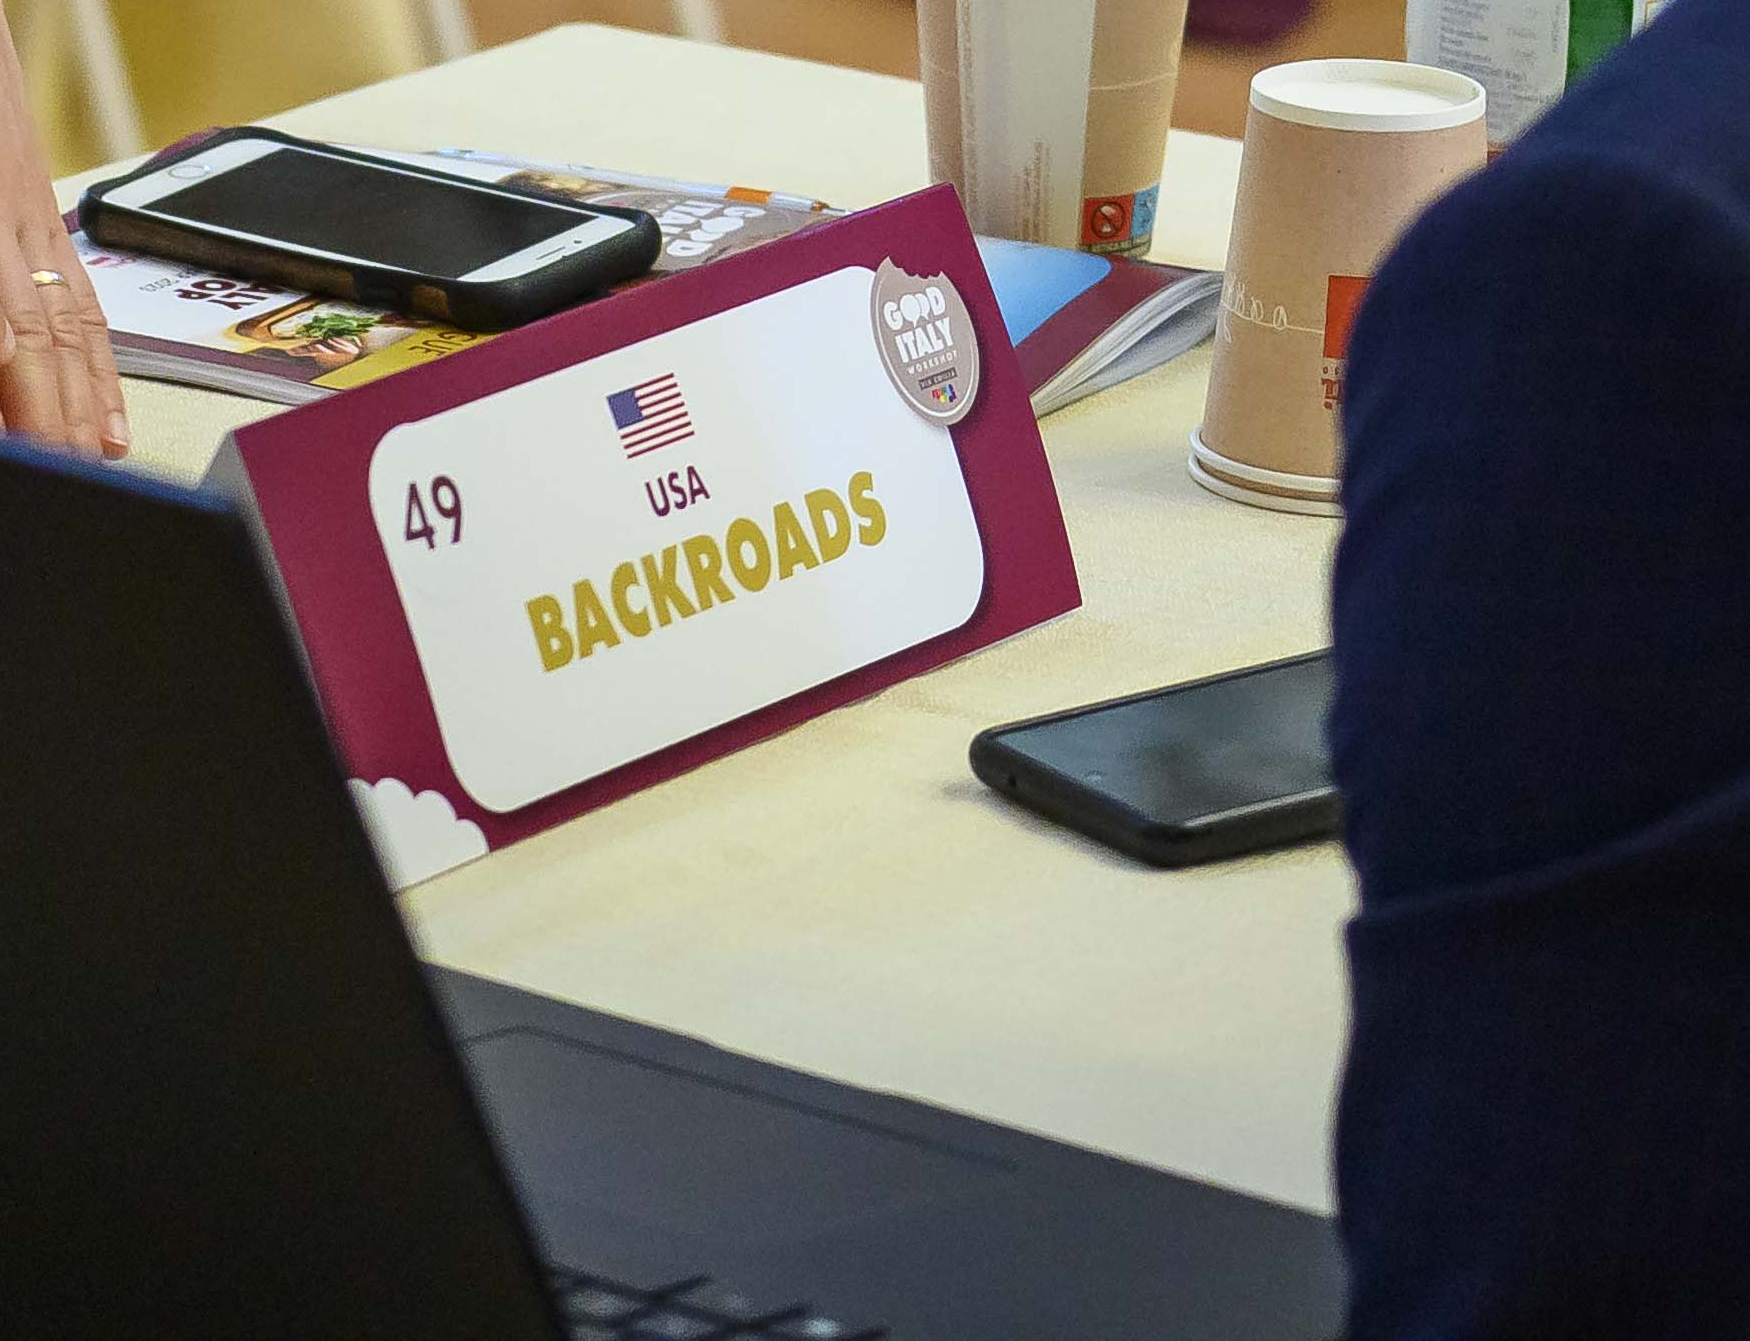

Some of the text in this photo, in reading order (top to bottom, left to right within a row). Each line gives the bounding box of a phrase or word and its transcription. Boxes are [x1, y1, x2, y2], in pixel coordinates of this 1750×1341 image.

[666, 205, 767, 257] GOOD
[883, 286, 946, 331] GOOD
[894, 316, 954, 363] ITALY
[906, 350, 957, 375] WORKSHOP
[404, 474, 464, 549] 49
[645, 465, 710, 517] USA
[525, 471, 888, 673] BACKROADS
